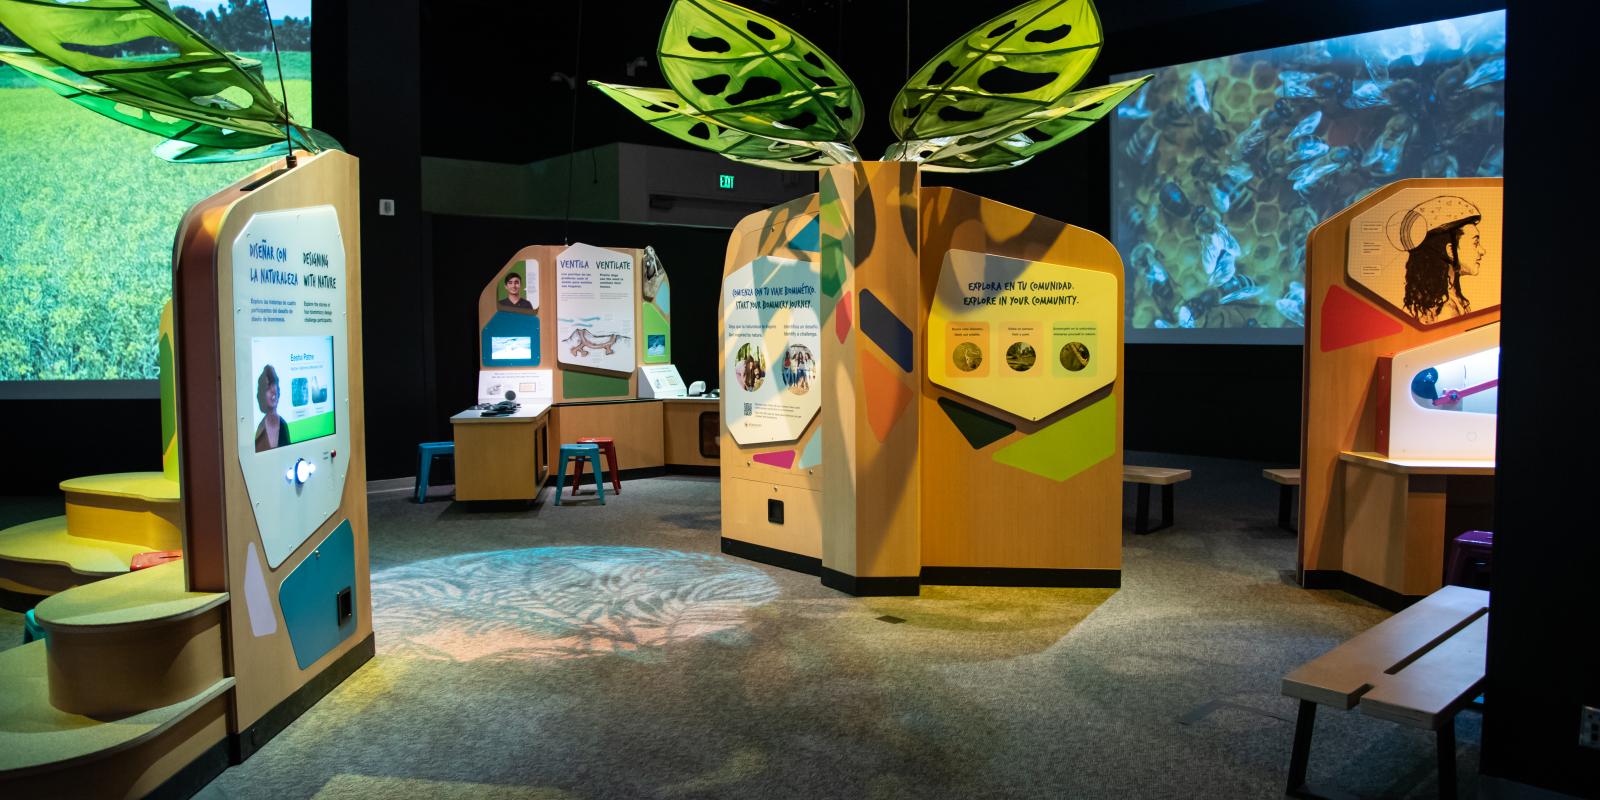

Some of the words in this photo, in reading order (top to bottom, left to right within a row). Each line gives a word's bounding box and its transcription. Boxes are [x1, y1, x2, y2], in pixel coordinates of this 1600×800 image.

[720, 174, 734, 188] EXIT
[249, 239, 274, 260] DISEÑAR
[276, 247, 287, 262] CON
[303, 252, 328, 268] DESIGNING
[560, 260, 590, 268] VENTILA
[596, 260, 630, 270] VENTILATE
[250, 268, 258, 282] LA
[260, 268, 298, 286] NATURALEZA
[304, 274, 316, 288] WITH
[318, 275, 336, 289] NATURE
[732, 288, 753, 296] COMIENZA
[764, 286, 770, 296] TU
[770, 286, 784, 296] VIAJE
[968, 282, 1002, 291] EXPLORA
[1004, 282, 1014, 291] EN
[1018, 281, 1028, 290] TU
[1030, 281, 1074, 291] COMUNIDAD.
[736, 300, 750, 310] START
[750, 301, 762, 310] YOUR
[963, 296, 996, 306] EXPLORE
[998, 296, 1008, 306] IN
[1010, 296, 1030, 306] YOUR
[1032, 296, 1080, 306] COMMUNITY.
